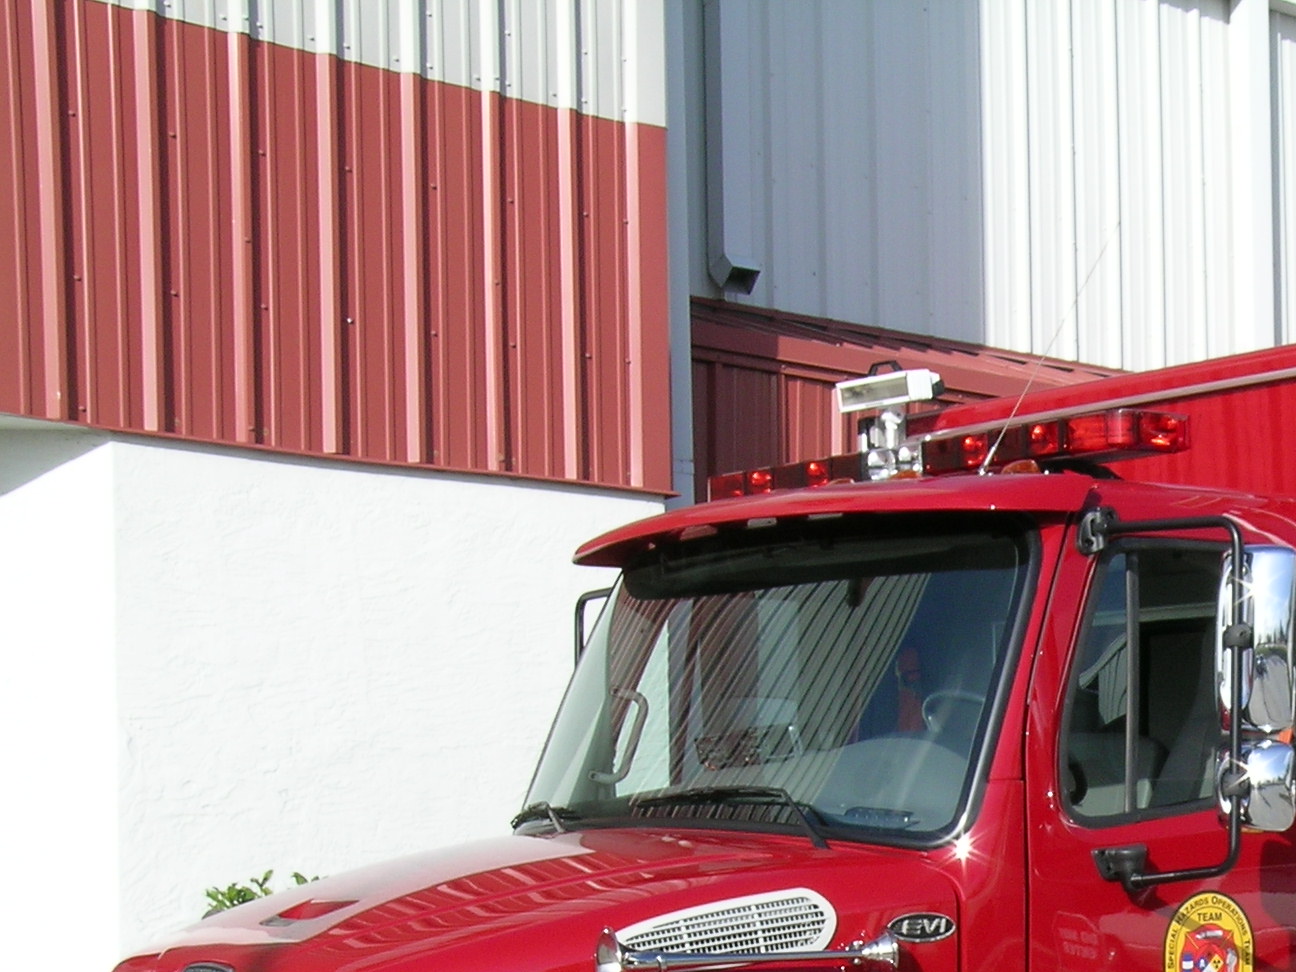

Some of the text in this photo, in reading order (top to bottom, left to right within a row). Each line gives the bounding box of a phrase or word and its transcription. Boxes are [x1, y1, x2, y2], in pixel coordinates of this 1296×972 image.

[1197, 912, 1223, 922] TEAM
[901, 918, 947, 935] EVI
[1167, 928, 1178, 969] SPECIAL
[1175, 897, 1209, 926] HAZARDS
[1211, 896, 1248, 936] OPERATIONS
